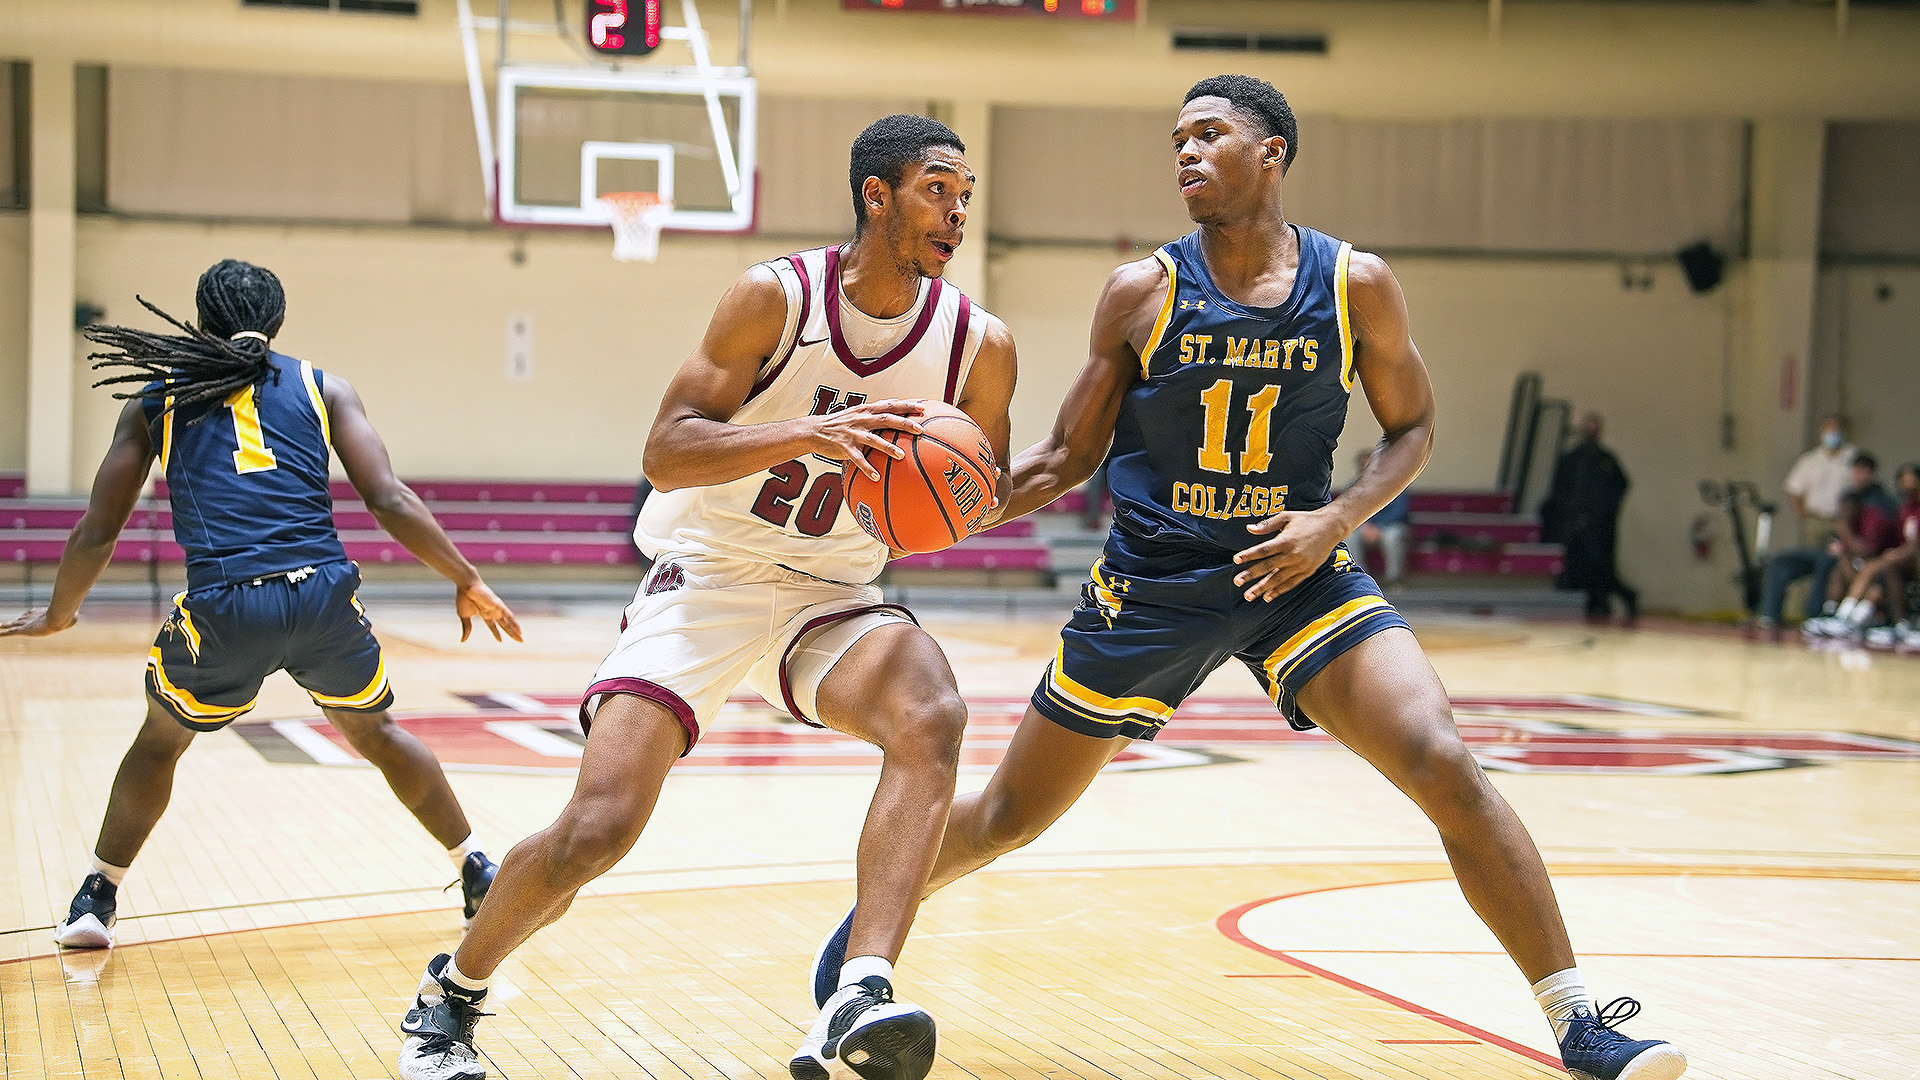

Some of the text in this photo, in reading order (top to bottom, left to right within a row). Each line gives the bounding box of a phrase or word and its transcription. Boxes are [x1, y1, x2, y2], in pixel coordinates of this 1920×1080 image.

[591, 0, 660, 49] 21
[1178, 334, 1319, 372] ST. MARY'S
[223, 384, 278, 475] 1
[1197, 378, 1282, 475] 11
[749, 458, 844, 538] 20
[1172, 480, 1289, 520] COLLEGE
